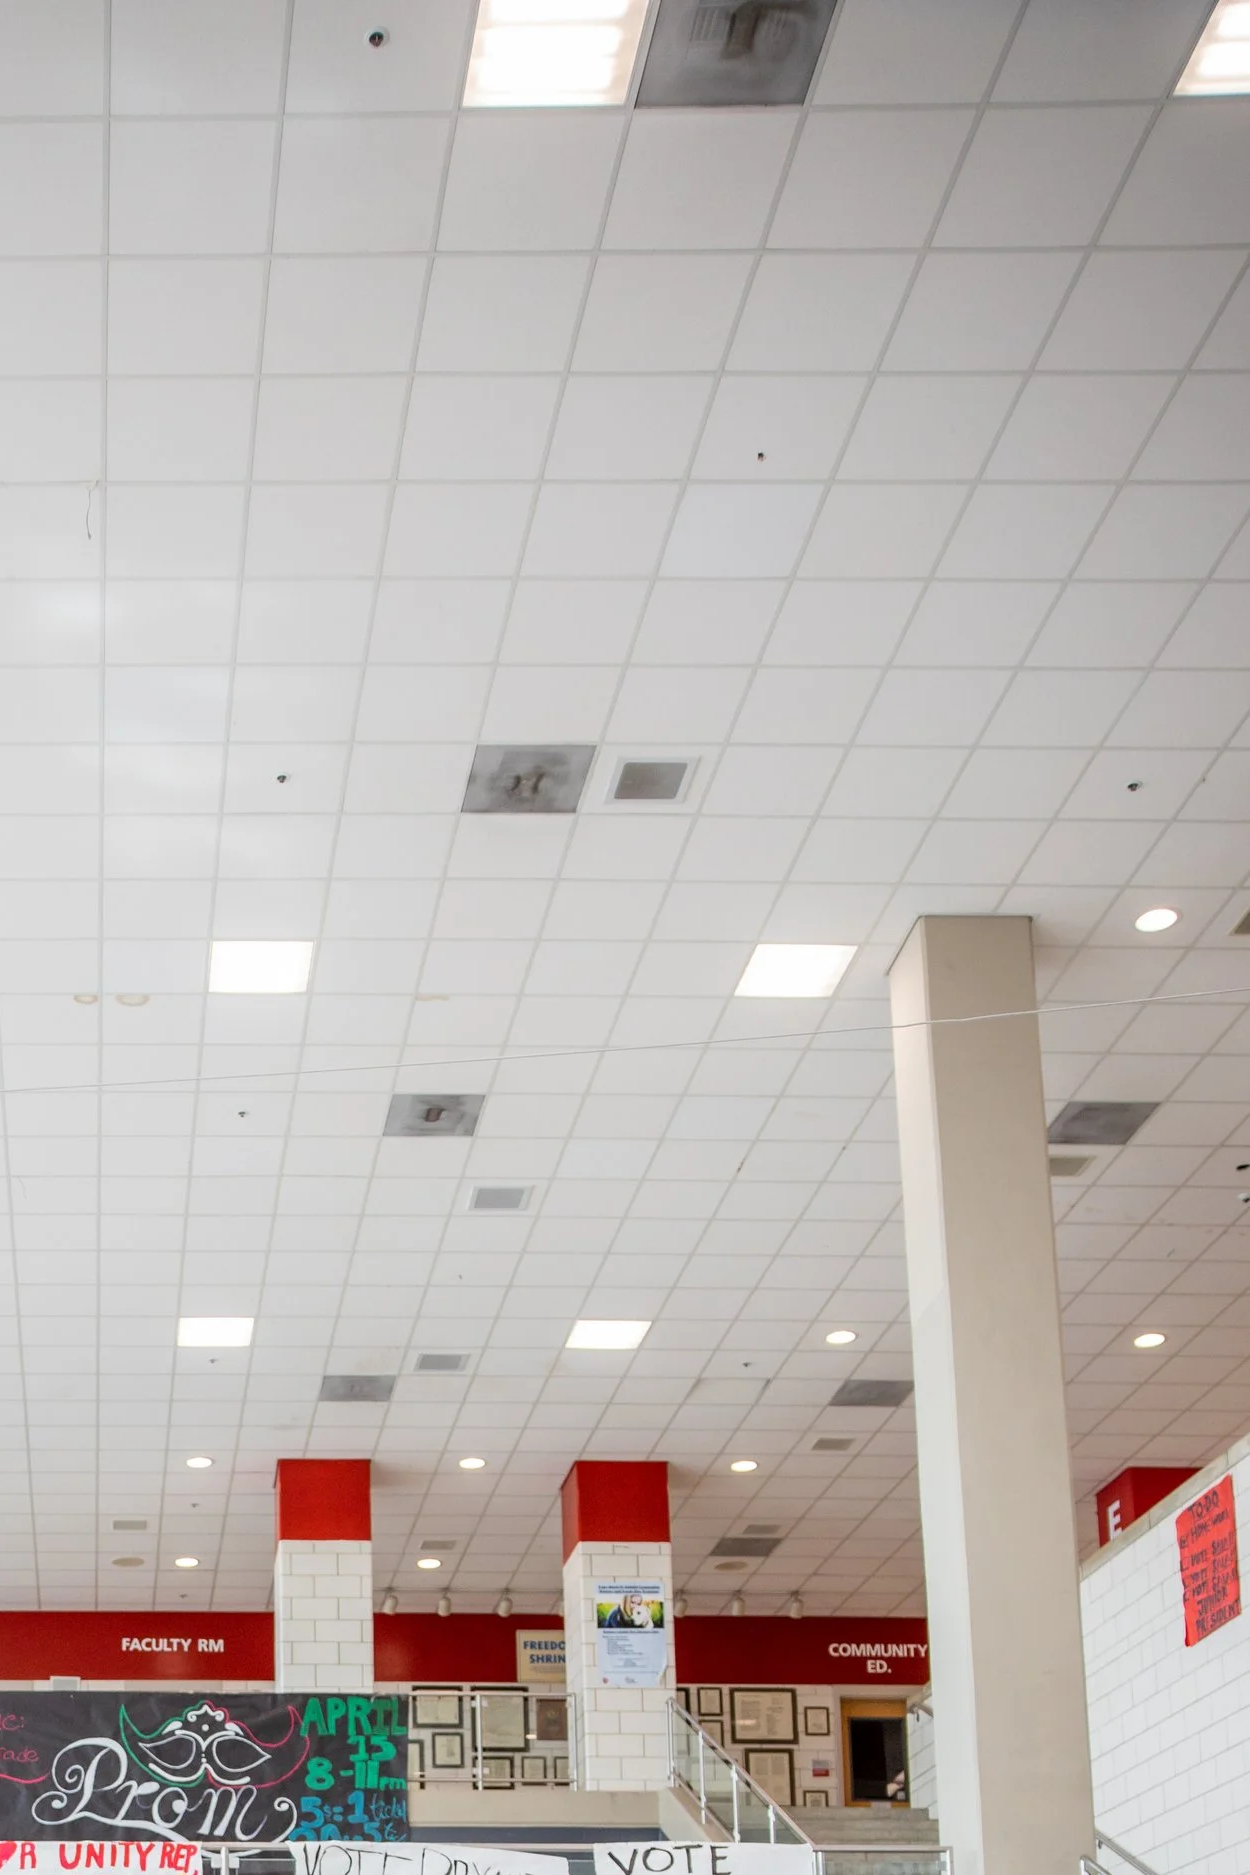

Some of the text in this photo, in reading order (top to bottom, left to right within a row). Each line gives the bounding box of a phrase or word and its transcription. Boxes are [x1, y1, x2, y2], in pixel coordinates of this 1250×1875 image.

[121, 1637, 224, 1653] FACULTY RM
[828, 1643, 928, 1658] COMMUNITY
[866, 1659, 892, 1674] ED.
[300, 1697, 407, 1736] APRIL
[347, 1735, 397, 1761] 15
[31, 1737, 268, 1842] Prom
[59, 1842, 155, 1871] UNITY
